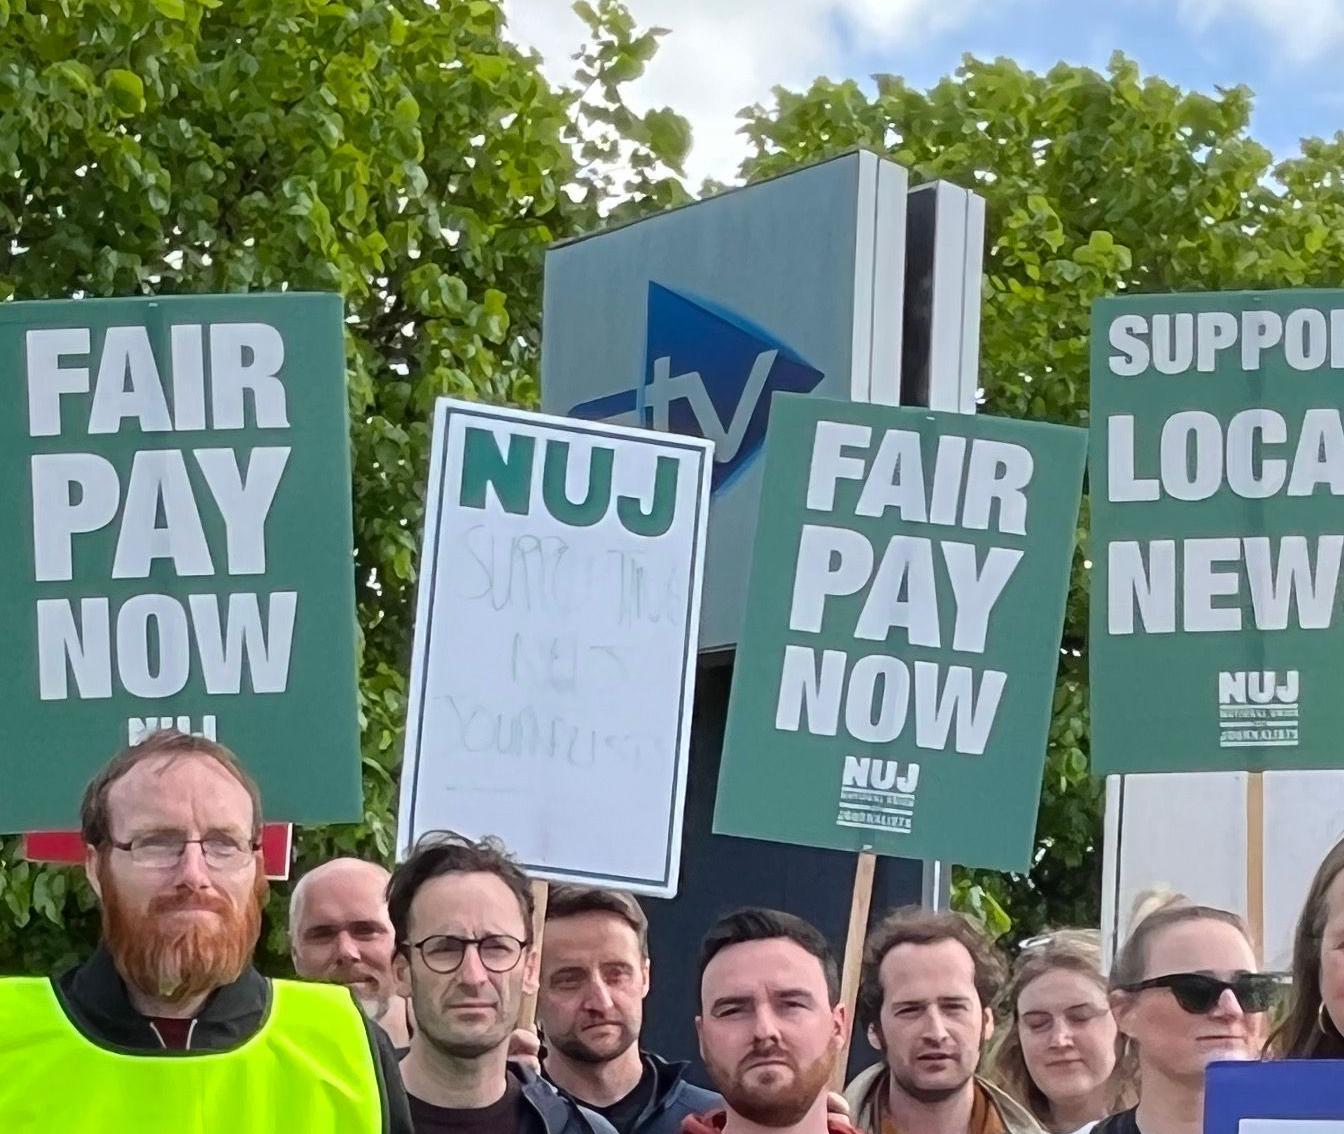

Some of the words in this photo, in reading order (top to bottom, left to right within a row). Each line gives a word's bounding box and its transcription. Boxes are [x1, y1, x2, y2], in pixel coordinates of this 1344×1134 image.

[26, 323, 290, 436] FAIR
[31, 447, 291, 581] PAY
[459, 427, 680, 537] NUJ
[807, 421, 1033, 535] FAIR
[790, 525, 1024, 653] PAY
[37, 592, 297, 700] NOW
[776, 645, 1007, 754] NOW
[1219, 671, 1299, 703] NUJ
[842, 756, 919, 793] NUJ
